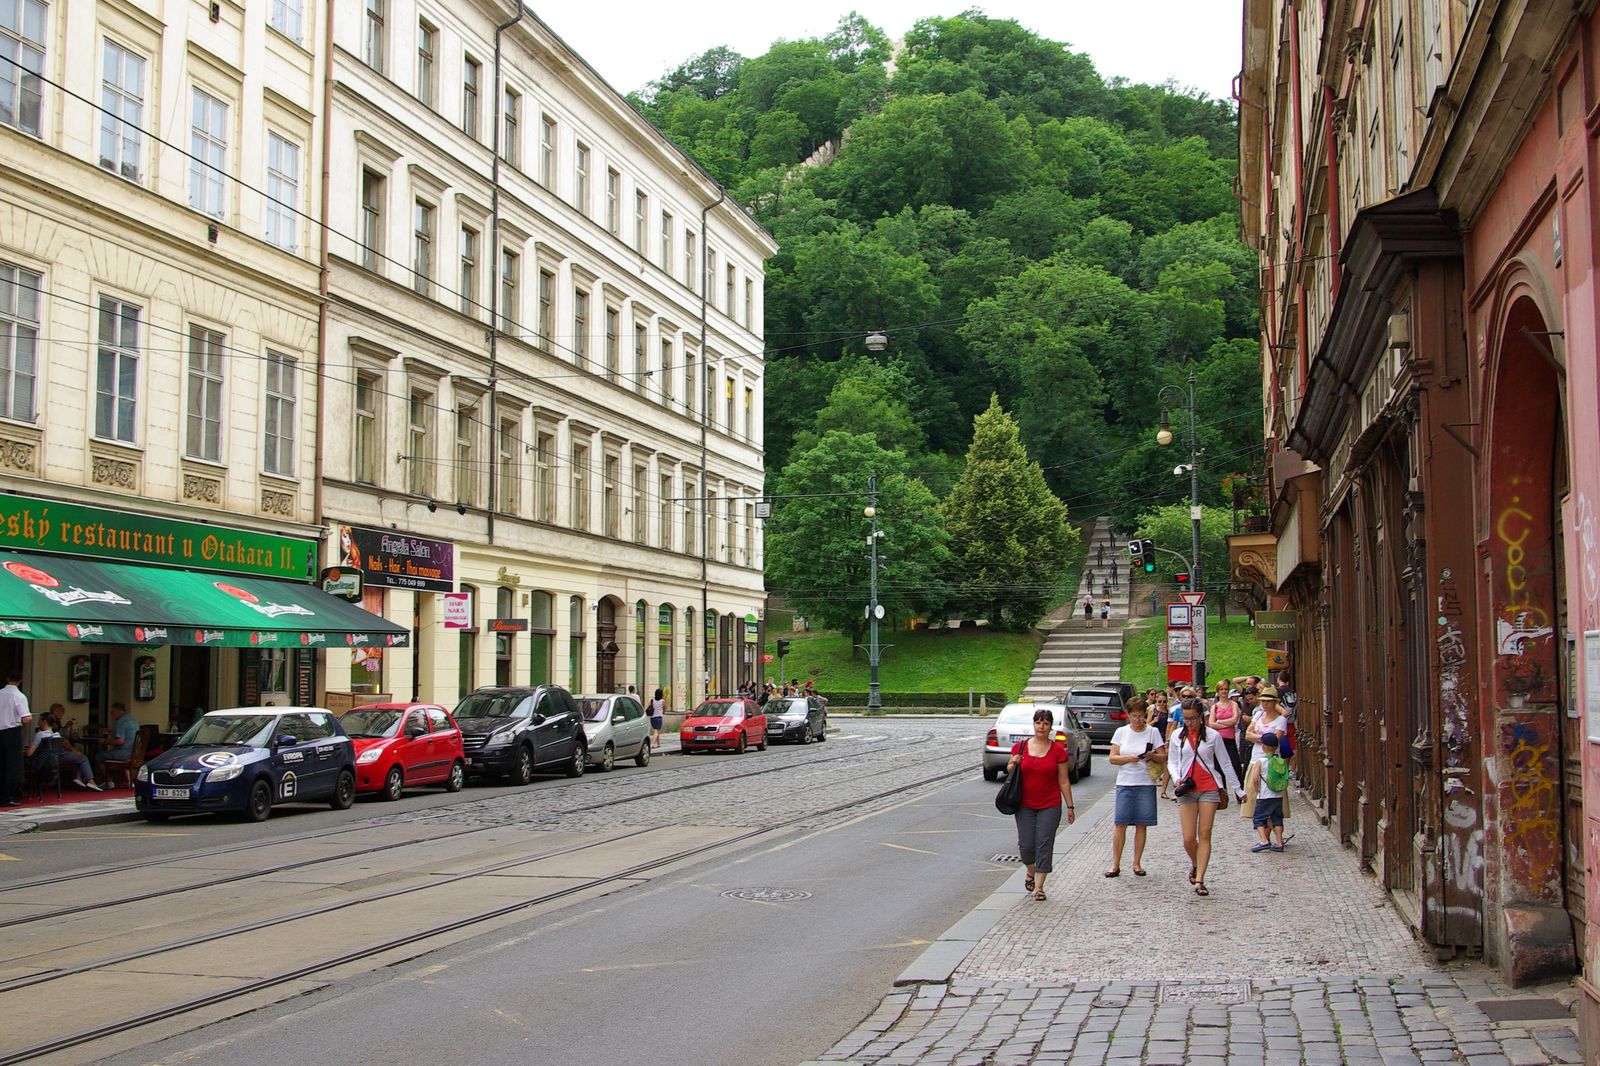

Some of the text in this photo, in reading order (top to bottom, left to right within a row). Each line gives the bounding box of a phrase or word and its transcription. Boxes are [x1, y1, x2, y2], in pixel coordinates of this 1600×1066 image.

[61, 522, 174, 555] restaurant
[183, 537, 193, 558] u
[201, 534, 273, 567] Otakara
[368, 555, 383, 571] Nails
[388, 557, 401, 574] Hair
[283, 781, 294, 798] E
